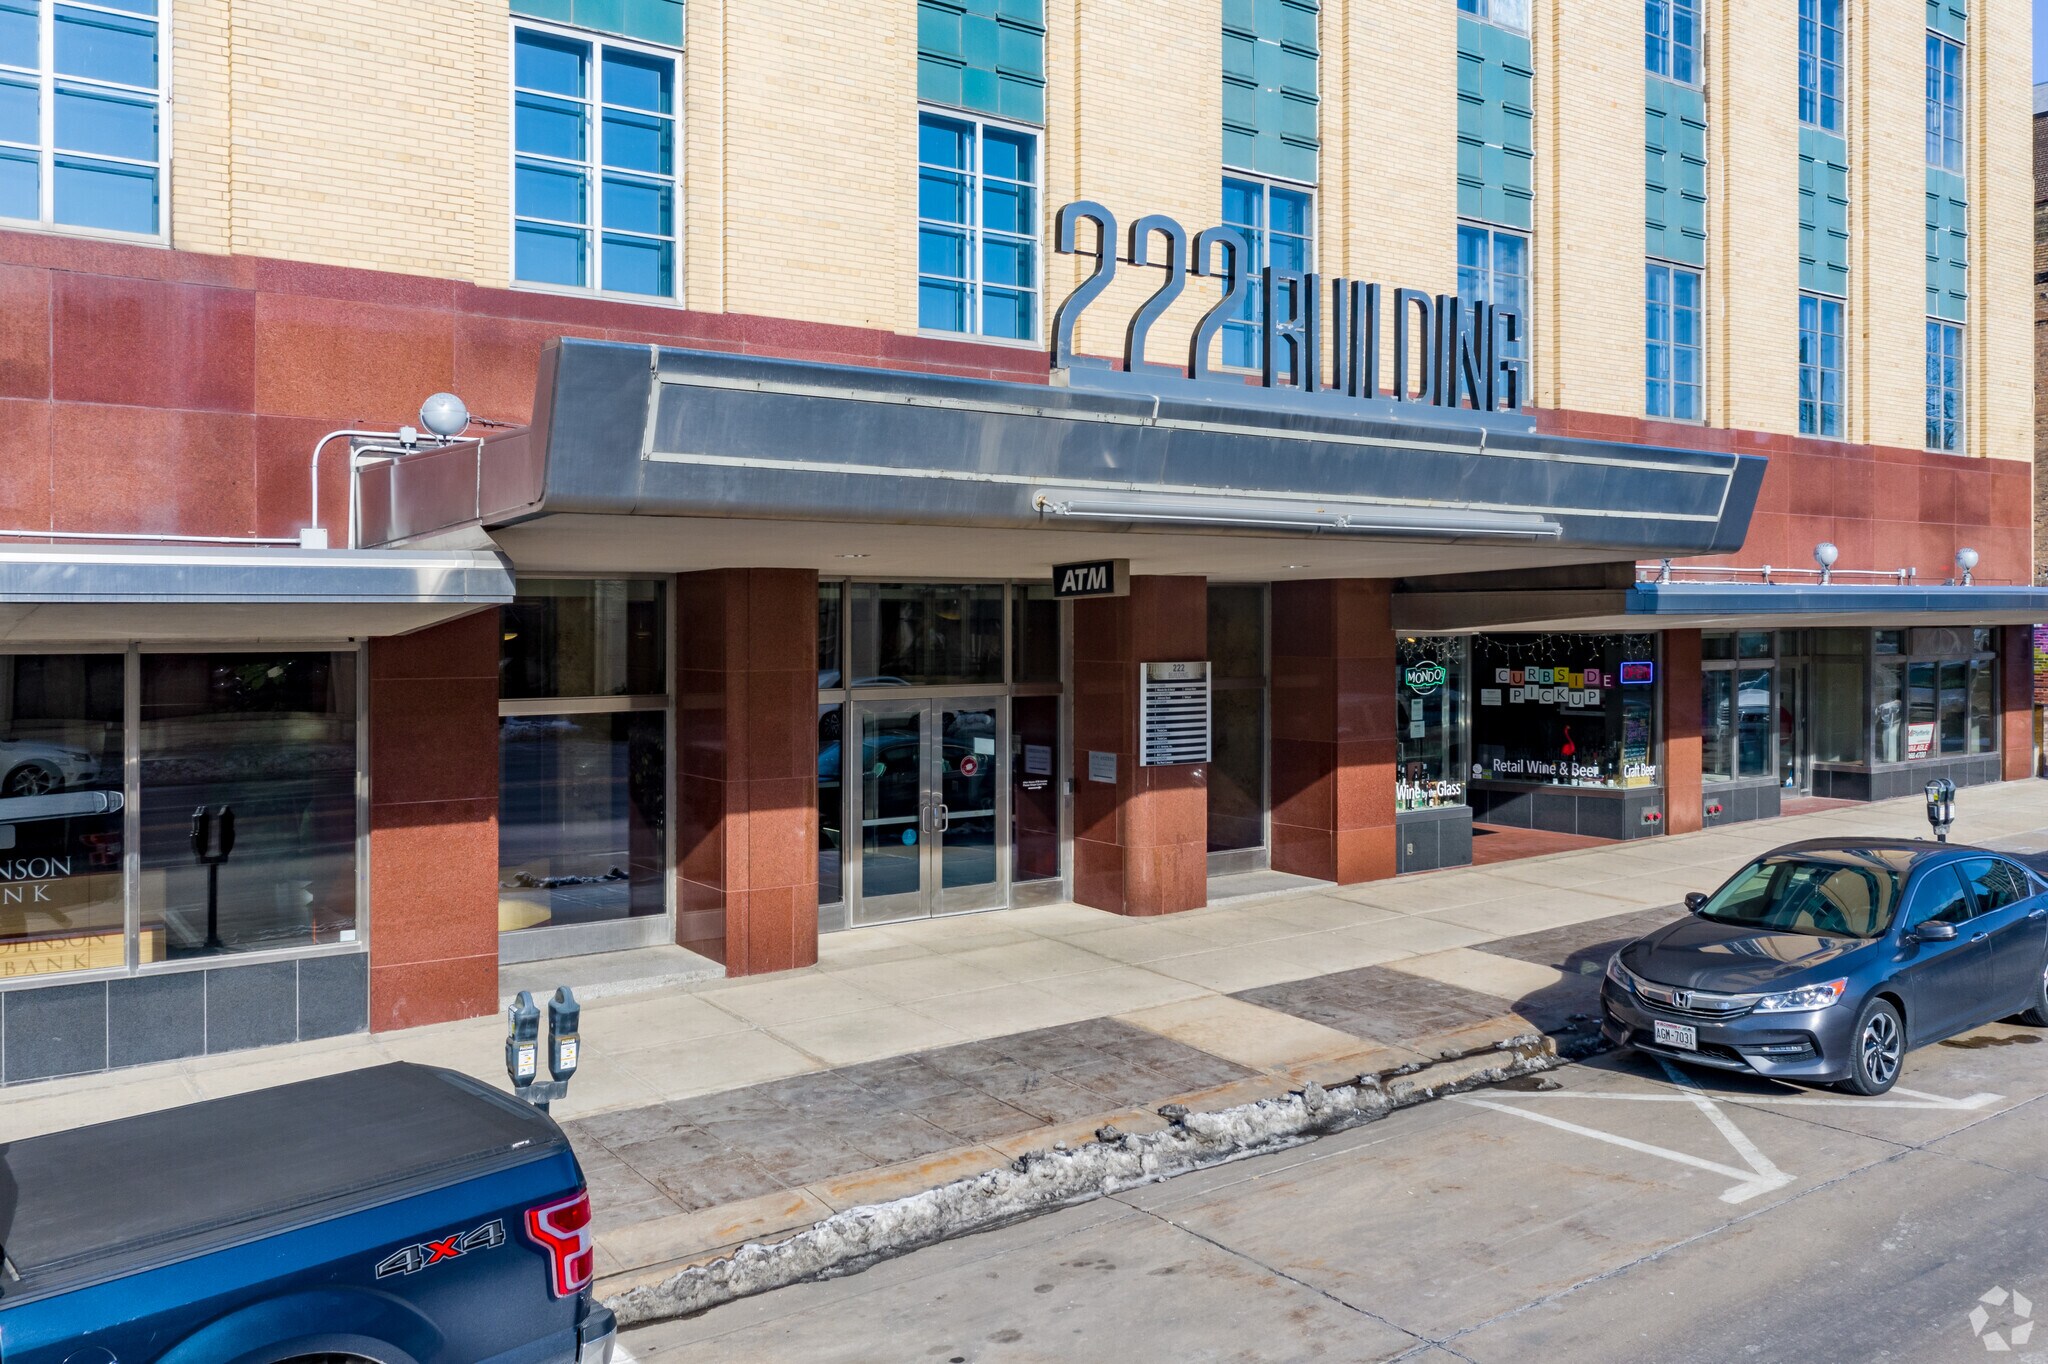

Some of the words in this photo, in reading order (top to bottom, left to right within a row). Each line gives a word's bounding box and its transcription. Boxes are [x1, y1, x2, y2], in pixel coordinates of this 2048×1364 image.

[1051, 200, 1248, 379] 222
[1262, 266, 1522, 414] BUILDING
[1061, 566, 1107, 592] ATM
[1173, 663, 1185, 672] 222
[1623, 666, 1650, 679] OPEN
[1498, 669, 1612, 687] CURBSIDE
[1513, 686, 1597, 705] PICKUP
[1493, 758, 1523, 773] Retail
[1527, 760, 1556, 774] Wine
[1560, 762, 1568, 776] &
[1572, 762, 1598, 777] Beer
[1624, 764, 1640, 778] Craft
[1641, 763, 1656, 776] Beer
[1396, 781, 1420, 800] Wine
[1437, 780, 1460, 796] Glass
[5, 953, 86, 976] BANK
[1656, 1028, 1692, 1045] AGM-7031
